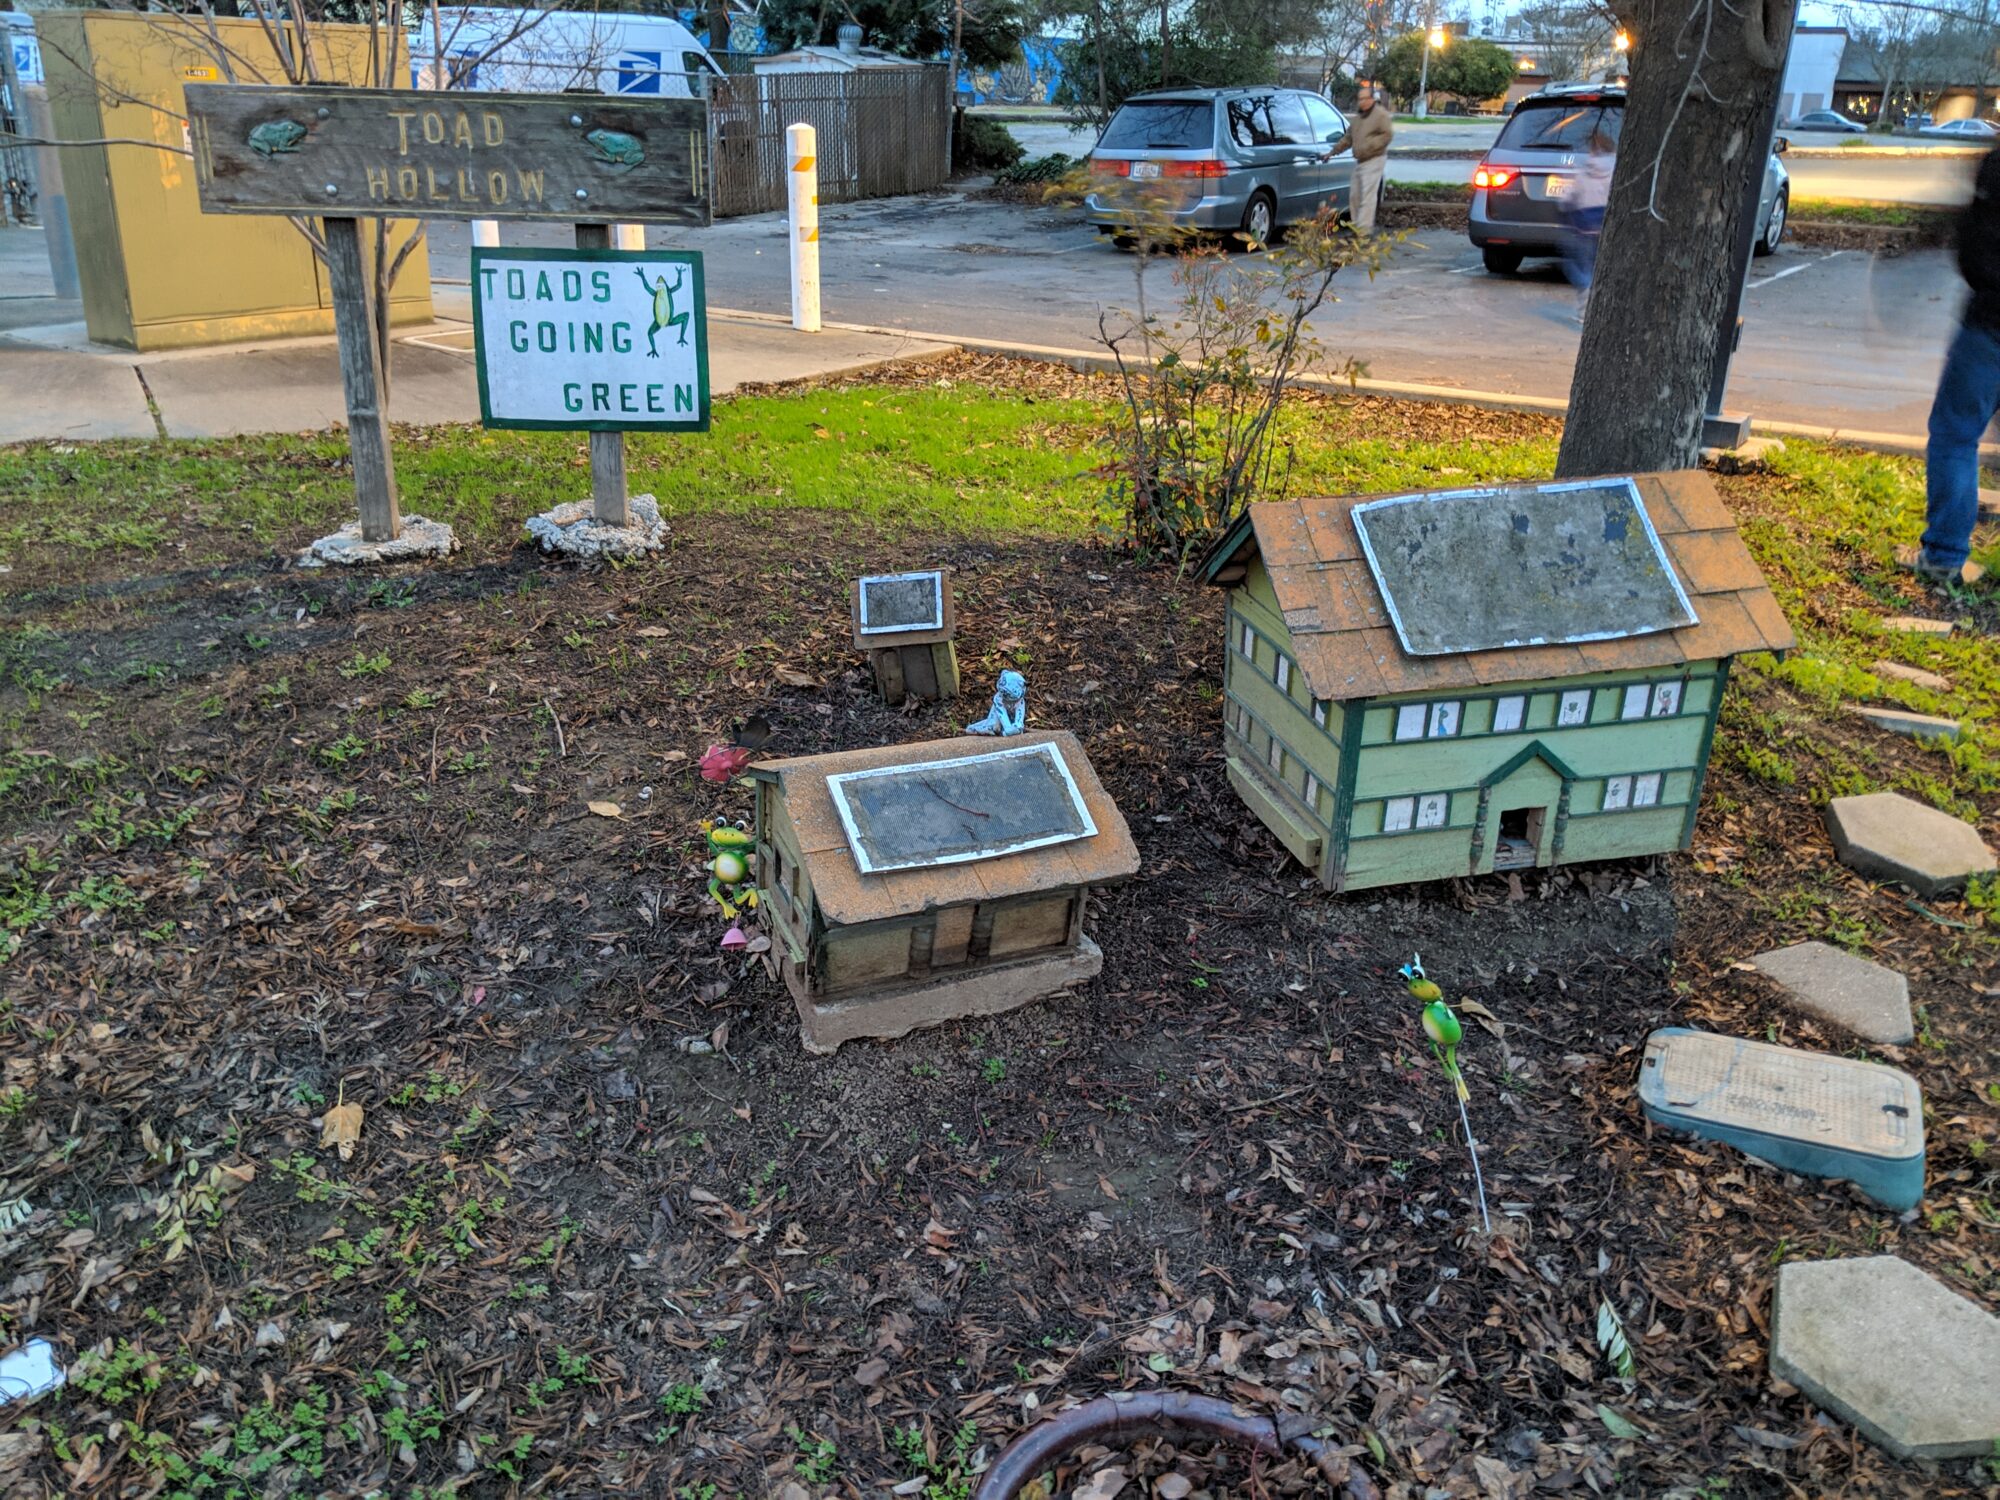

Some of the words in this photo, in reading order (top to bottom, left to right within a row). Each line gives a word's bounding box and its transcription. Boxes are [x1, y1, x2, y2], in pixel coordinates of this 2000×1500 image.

[387, 107, 504, 156] TOAD
[366, 165, 544, 204] HOLLOW
[480, 268, 611, 303] TOADS
[509, 320, 632, 354] GOING
[563, 382, 693, 413] GREEN
